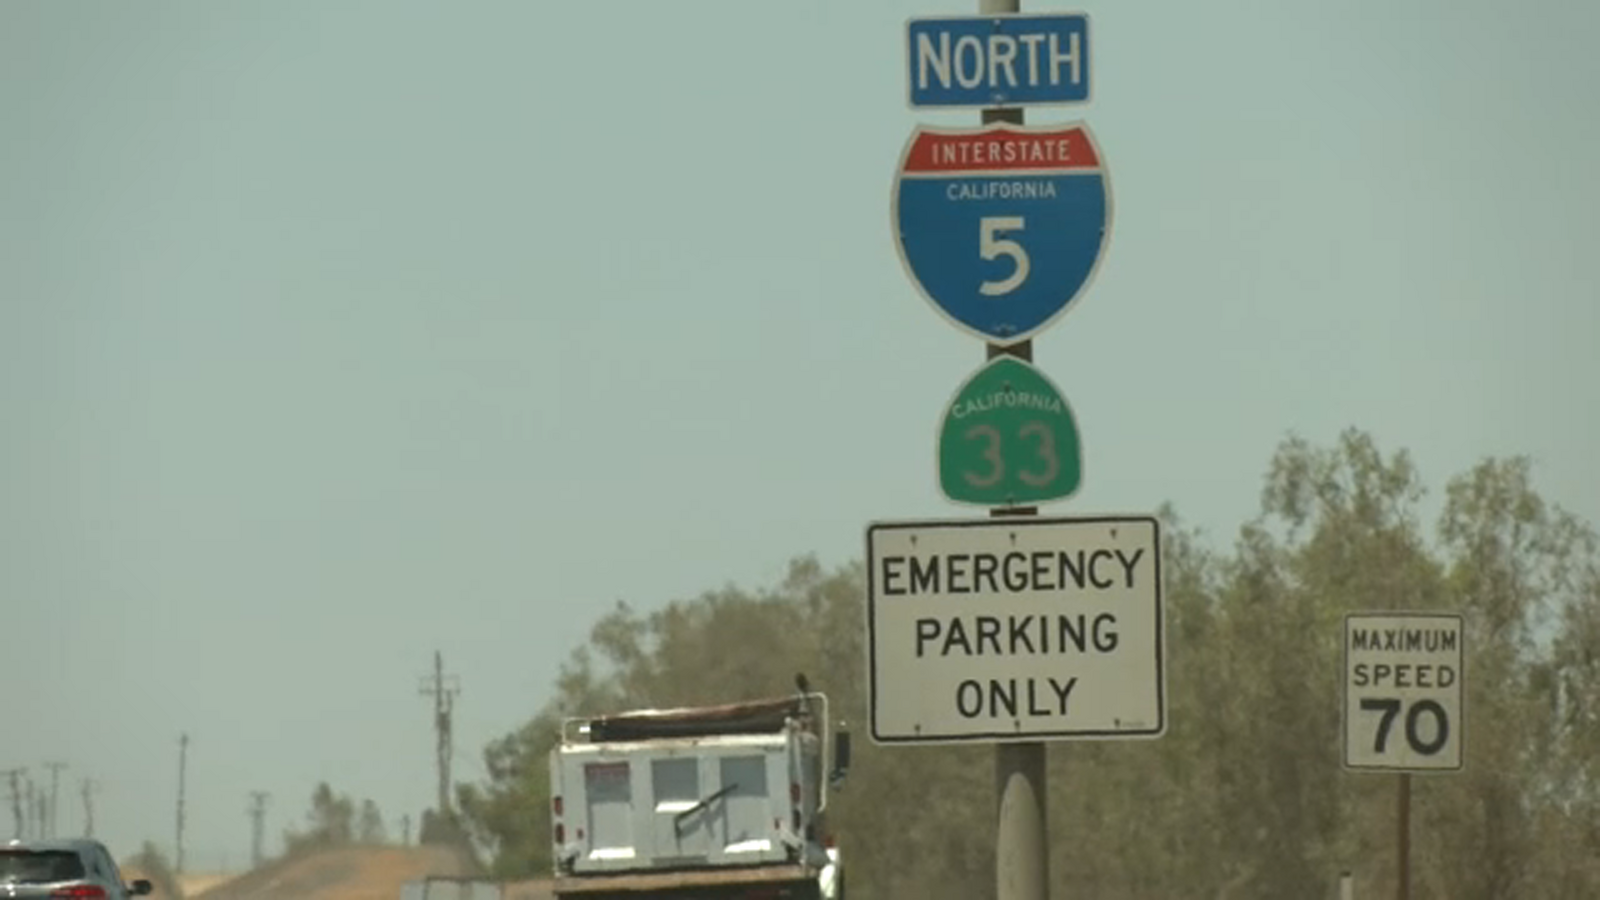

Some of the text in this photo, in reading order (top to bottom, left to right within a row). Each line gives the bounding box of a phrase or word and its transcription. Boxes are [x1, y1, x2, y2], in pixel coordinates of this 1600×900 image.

[916, 32, 1081, 89] NORTH
[931, 140, 1071, 164] INTERSTATE
[946, 182, 1057, 201] CALIFORNIA
[978, 216, 1031, 296] 5
[951, 391, 1062, 419] CALIFORNIA
[963, 420, 1060, 487] 33
[882, 548, 1145, 595] EMERGENCY
[916, 613, 1119, 657] PARKING
[1352, 629, 1456, 652] MAXIMUM
[1353, 664, 1455, 688] SPEED
[956, 677, 1078, 718] ONLY
[1360, 698, 1449, 756] 70
